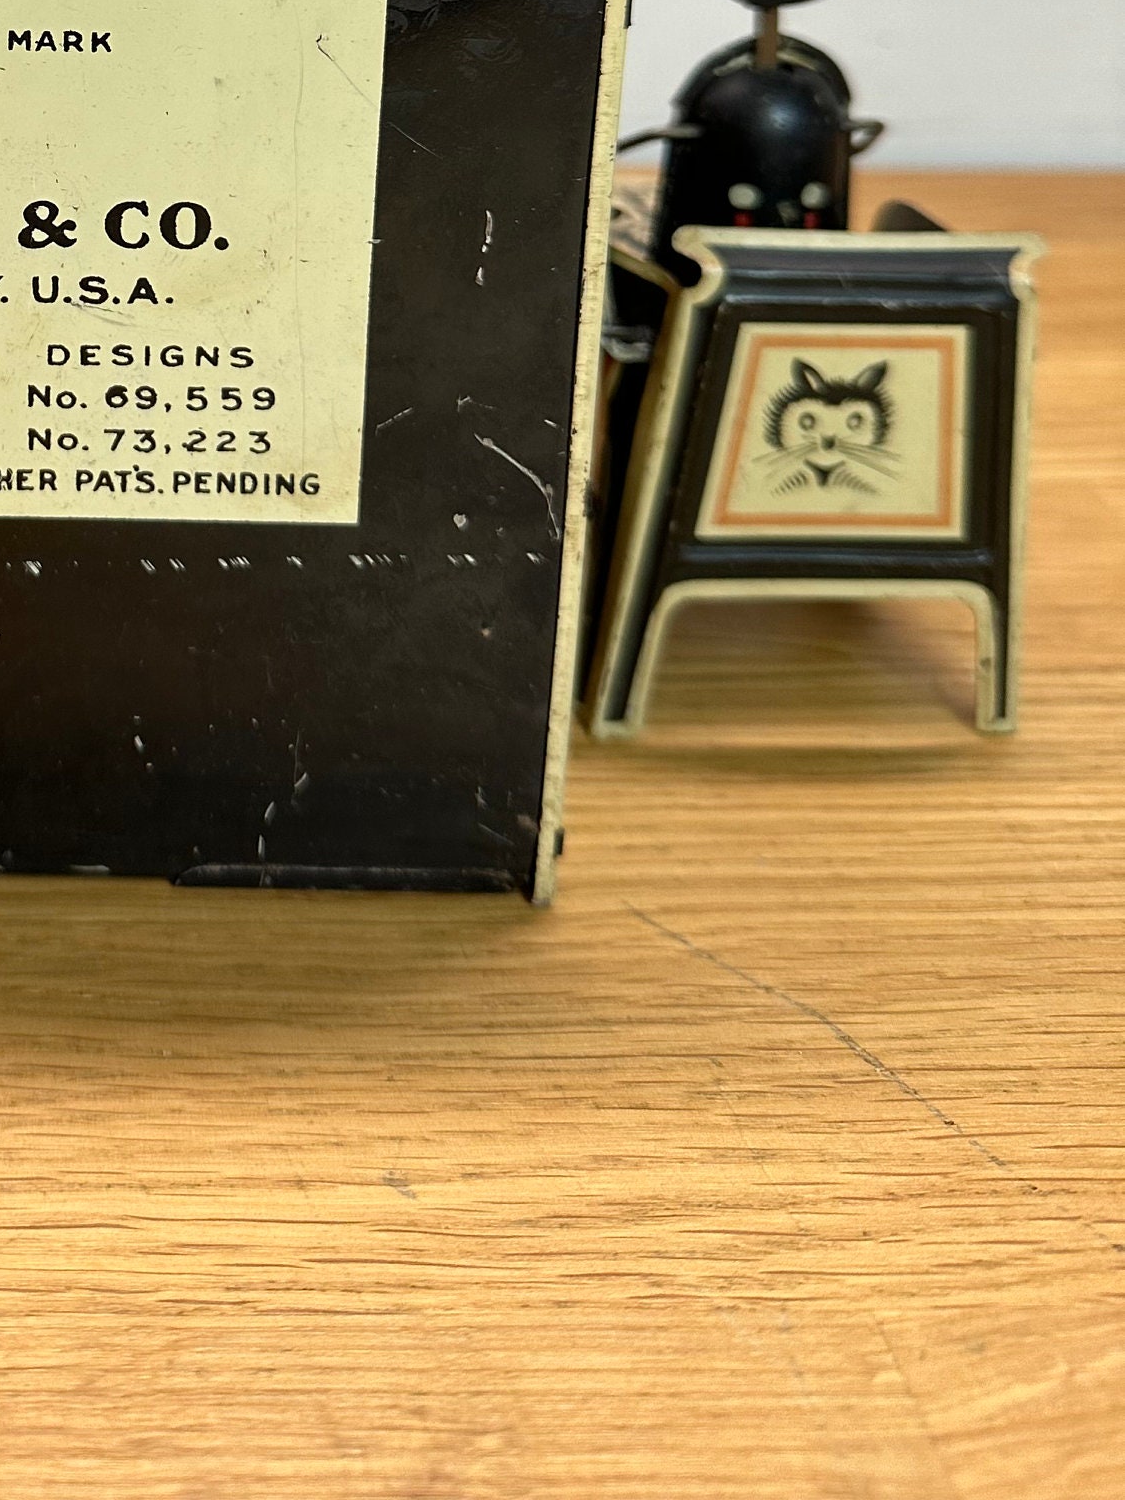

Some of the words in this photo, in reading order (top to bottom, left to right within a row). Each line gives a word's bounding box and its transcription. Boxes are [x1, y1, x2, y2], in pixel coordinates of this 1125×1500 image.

[7, 29, 112, 53] MARK
[17, 200, 78, 250] &
[104, 200, 230, 251] CO.
[31, 275, 174, 305] U.S.A.
[47, 344, 254, 369] DESIGNS
[27, 384, 88, 409] No.
[105, 385, 276, 413] 69,559
[27, 428, 89, 451] No.
[103, 429, 271, 455] 73,223
[172, 471, 320, 496] PENDING
